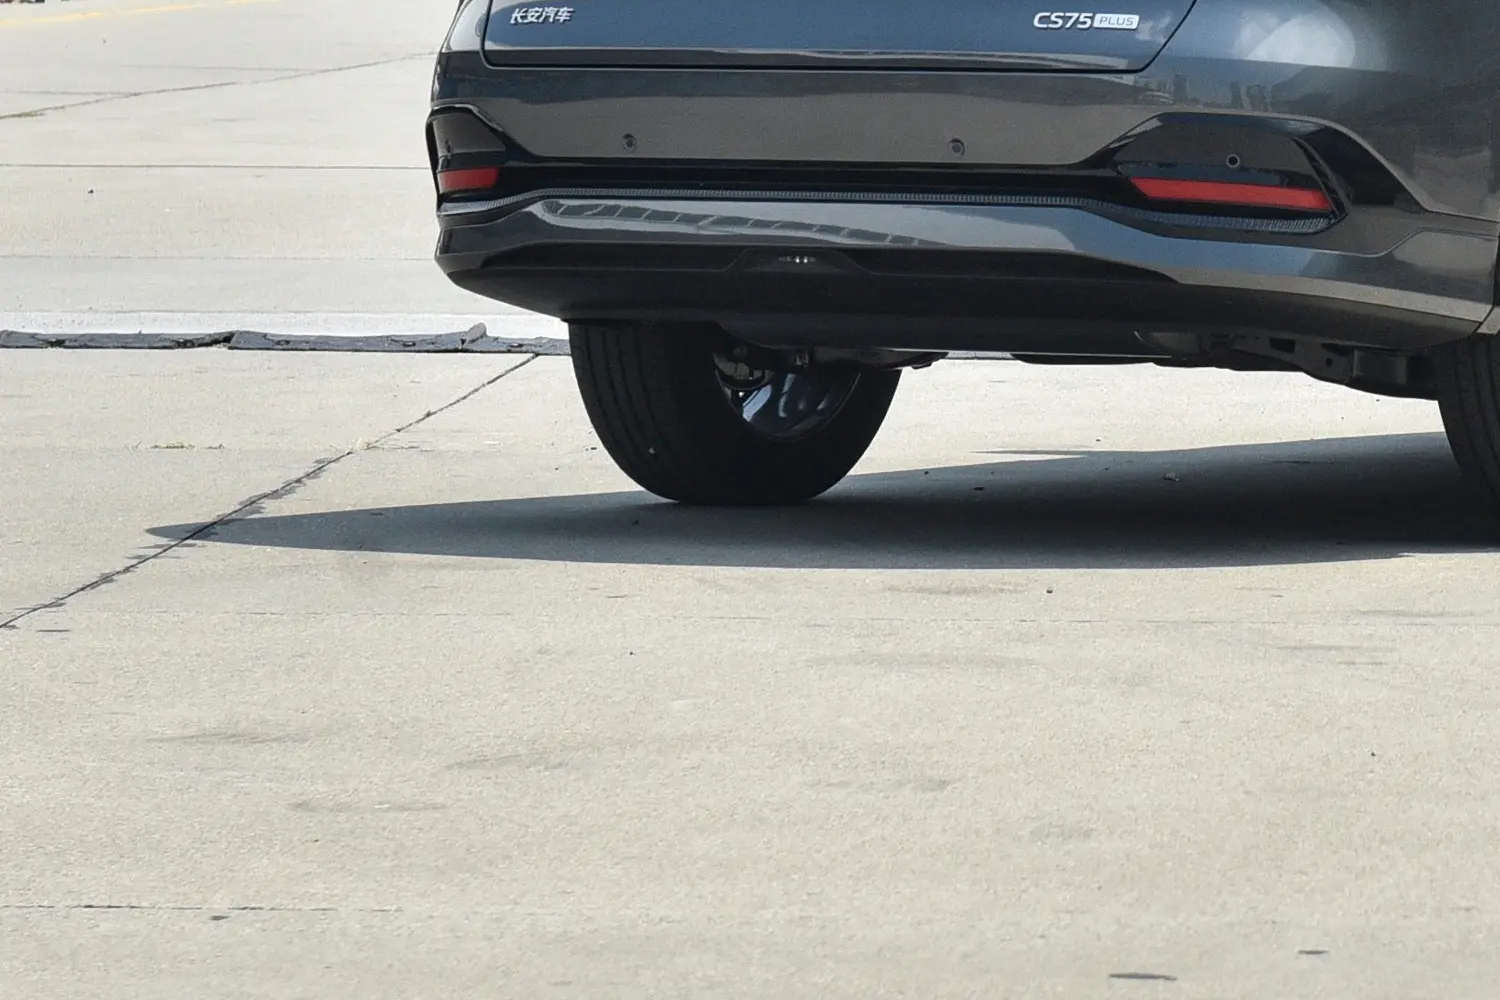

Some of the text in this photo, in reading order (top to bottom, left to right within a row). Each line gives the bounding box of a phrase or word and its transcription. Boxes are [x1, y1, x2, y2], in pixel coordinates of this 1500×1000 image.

[509, 6, 575, 24] 长安汽车
[1033, 12, 1135, 29] CS75 PLUS
